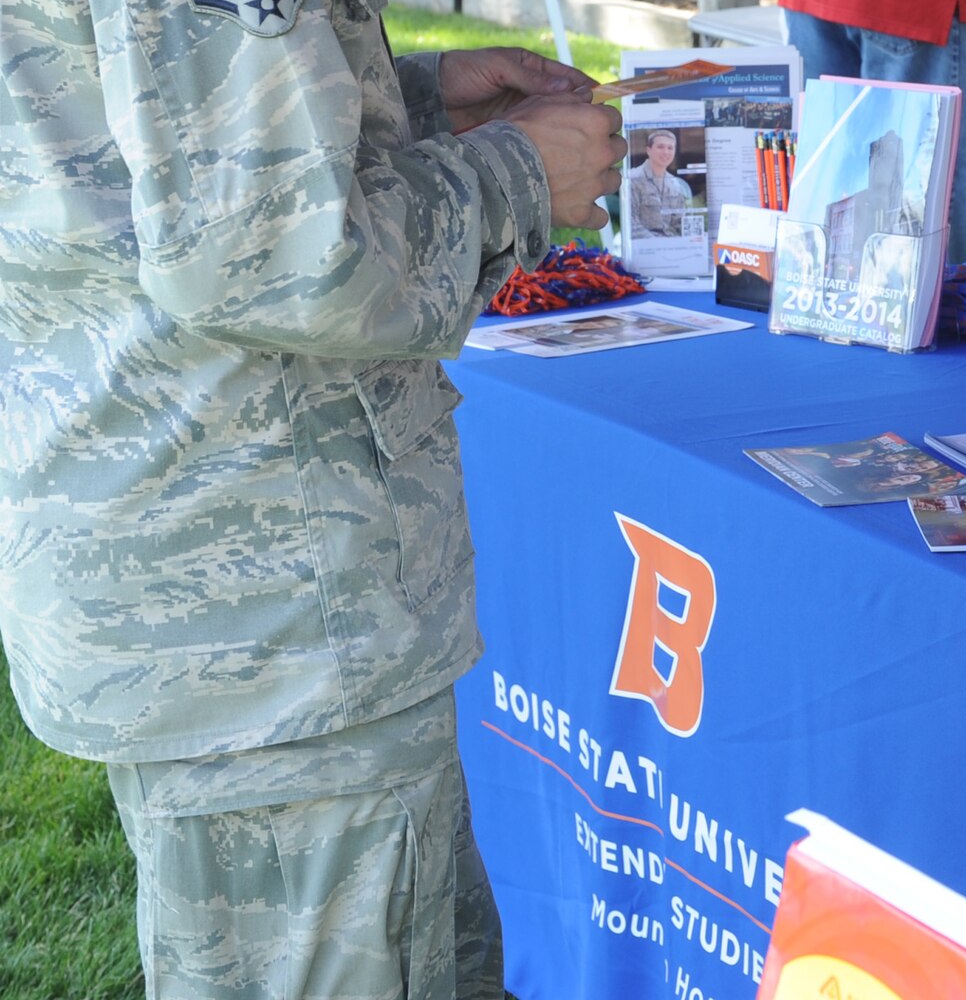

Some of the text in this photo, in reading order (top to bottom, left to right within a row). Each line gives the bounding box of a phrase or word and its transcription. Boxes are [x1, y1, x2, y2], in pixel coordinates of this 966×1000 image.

[719, 73, 751, 84] Applied
[752, 72, 785, 82] Science
[731, 250, 760, 267] OASC
[782, 285, 902, 329] 2013-2014
[786, 271, 904, 300] BOISE STATE UNIVERSITY
[780, 312, 902, 344] UNDERGRADUATE CATALOG
[609, 510, 717, 738] B
[492, 669, 784, 908] BOISE STAT UNIVE
[574, 811, 765, 985] EXTEND STUDIE
[590, 892, 665, 947] Moun
